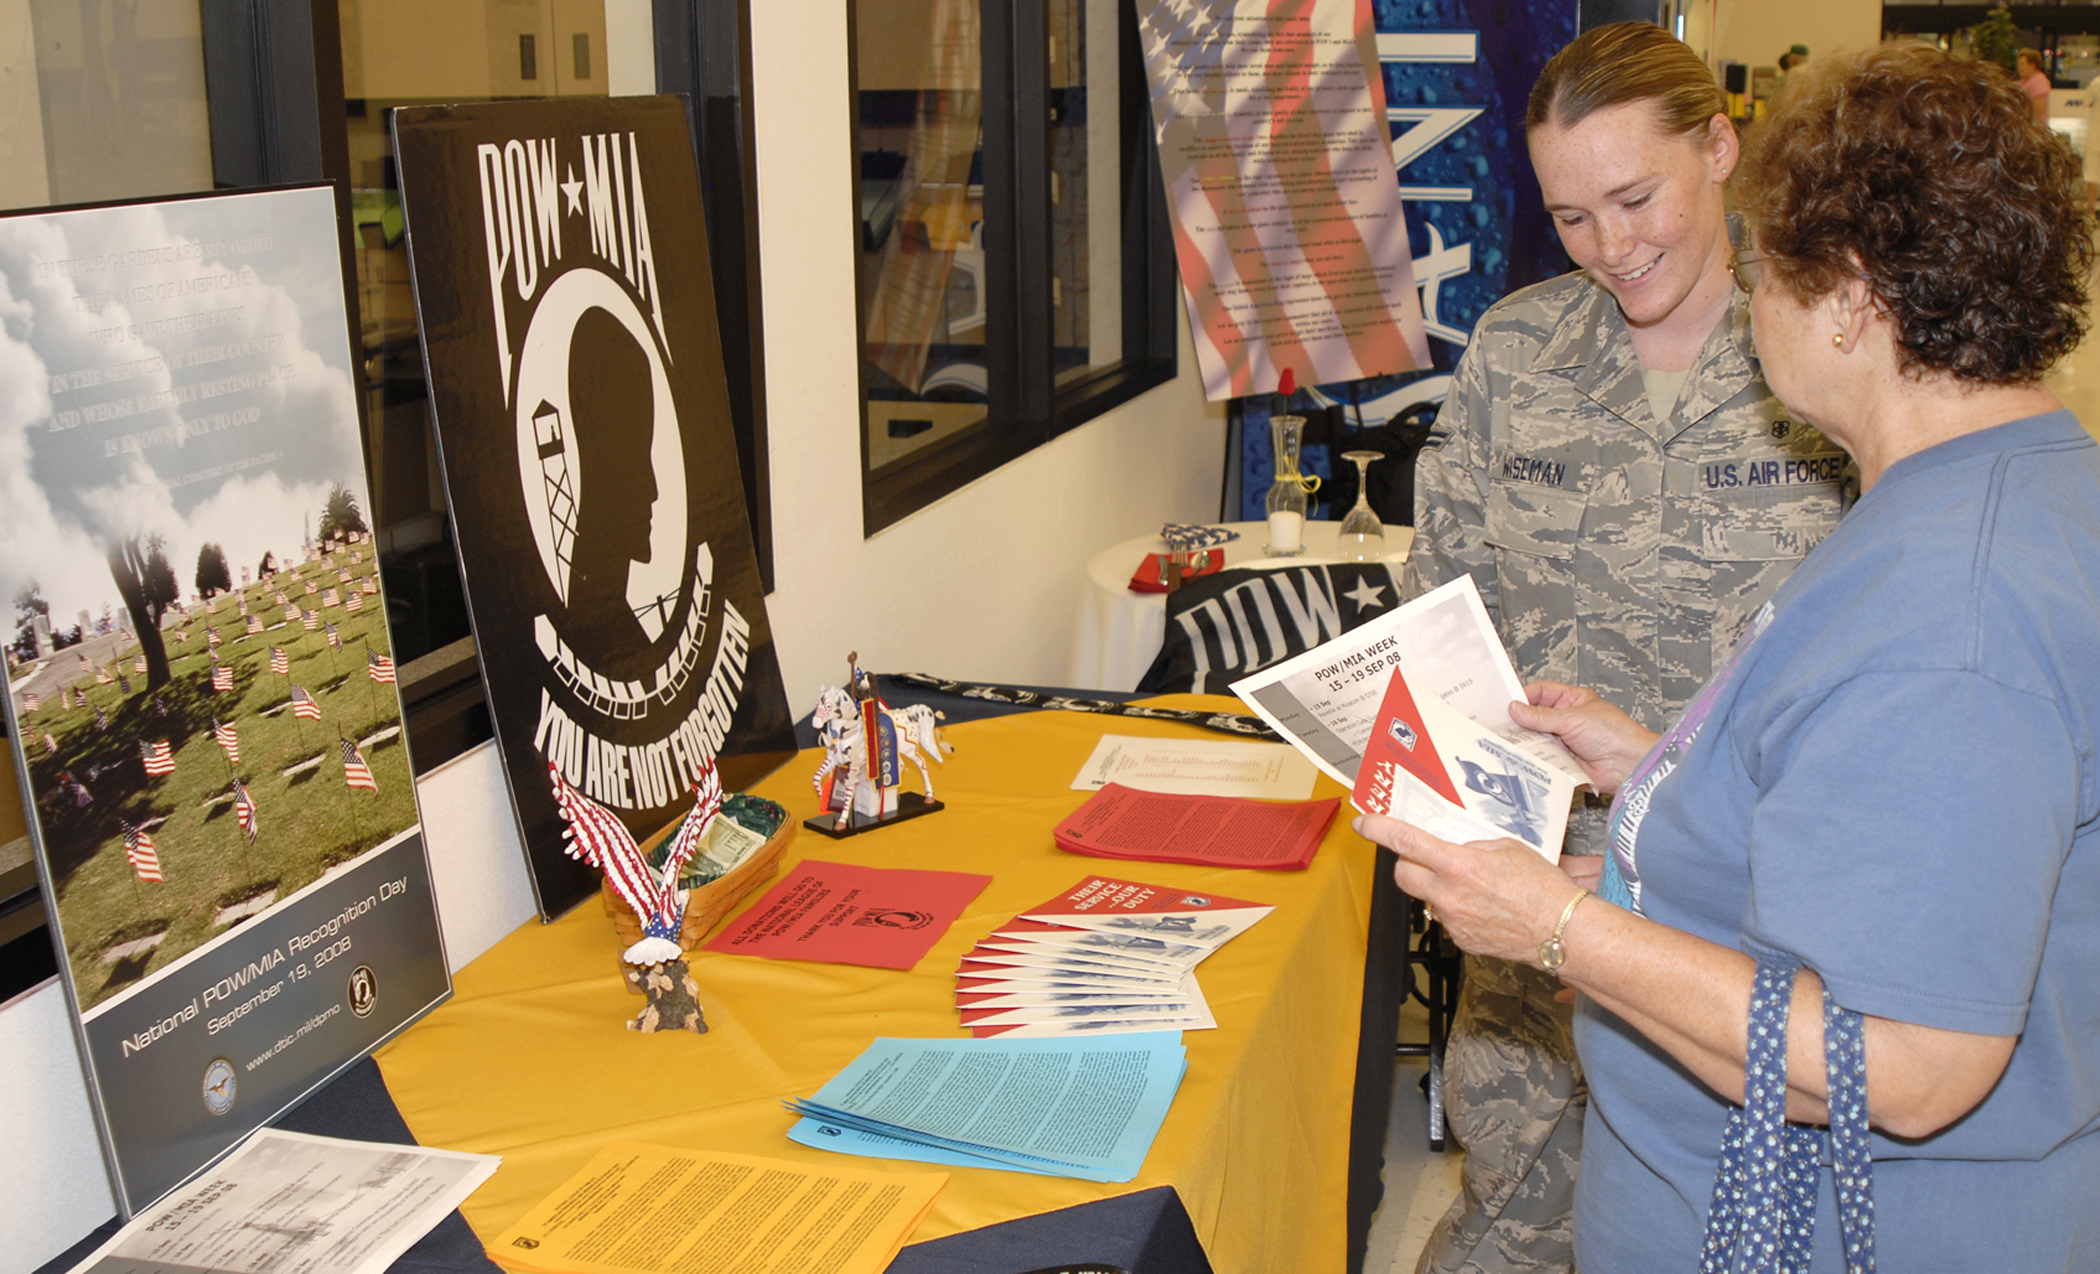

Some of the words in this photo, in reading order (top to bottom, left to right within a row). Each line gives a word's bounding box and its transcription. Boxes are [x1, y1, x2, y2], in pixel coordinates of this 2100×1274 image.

[477, 139, 561, 411] POW
[581, 131, 674, 366] MIA
[48, 410, 81, 433] AND
[233, 404, 260, 427] GOD
[1706, 463, 1743, 489] U.S.
[1748, 460, 1780, 486] AIR
[1785, 456, 1841, 484] FORCE
[1174, 565, 1342, 694] POW
[1314, 649, 1367, 683] POW/MIA
[1364, 635, 1399, 662] WEEK
[1329, 679, 1343, 692] 15
[1351, 671, 1365, 686] 19
[1364, 660, 1386, 681] SEP
[1385, 651, 1401, 668] 08
[534, 686, 584, 789] YOU
[585, 733, 633, 810] ARE
[629, 738, 679, 810] NOT
[669, 598, 750, 793] FORGOTTEN
[1068, 879, 1106, 902] THEIR
[1074, 882, 1123, 911] SERVICE
[1122, 887, 1156, 910] DUTY
[122, 997, 199, 1058] National
[202, 948, 285, 1009] POW/MIA
[288, 895, 377, 955] Recognition
[379, 875, 408, 902] Day
[207, 981, 284, 1036] September
[287, 963, 312, 983] 19,
[314, 935, 352, 970] 2008
[245, 1003, 341, 1072] www.dtic.mil/dpmo
[144, 1198, 200, 1233] POW/MIA
[194, 1178, 228, 1200] WEEK
[164, 1220, 182, 1233] 15
[188, 1204, 205, 1216] 19
[202, 1192, 222, 1207] SEP
[220, 1182, 238, 1193] 08
